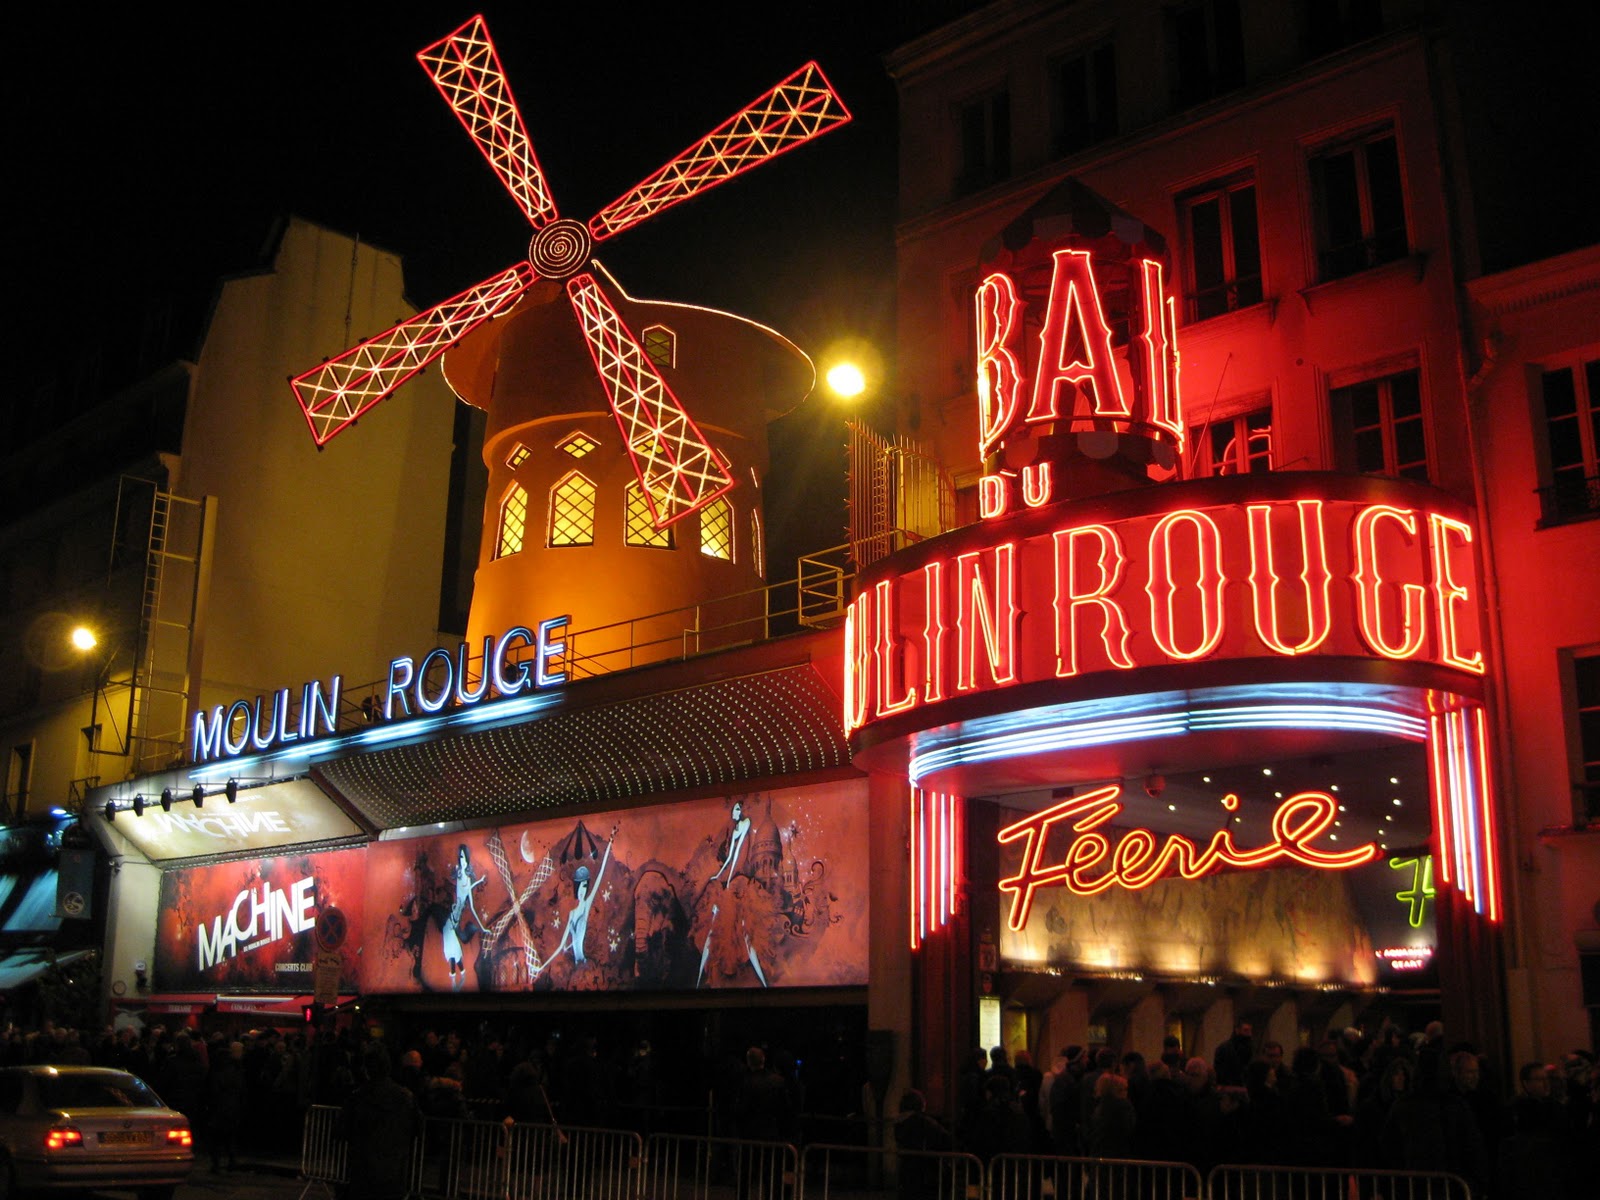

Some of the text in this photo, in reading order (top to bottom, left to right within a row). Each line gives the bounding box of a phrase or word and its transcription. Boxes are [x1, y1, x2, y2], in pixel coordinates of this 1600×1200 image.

[975, 249, 1185, 463] BAL
[979, 462, 1052, 519] DU
[192, 614, 571, 762] MOULIN ROUGE
[843, 499, 1484, 740] ULIN ROUGE
[198, 876, 316, 971] MACHINE
[997, 783, 1378, 931] Féerie
